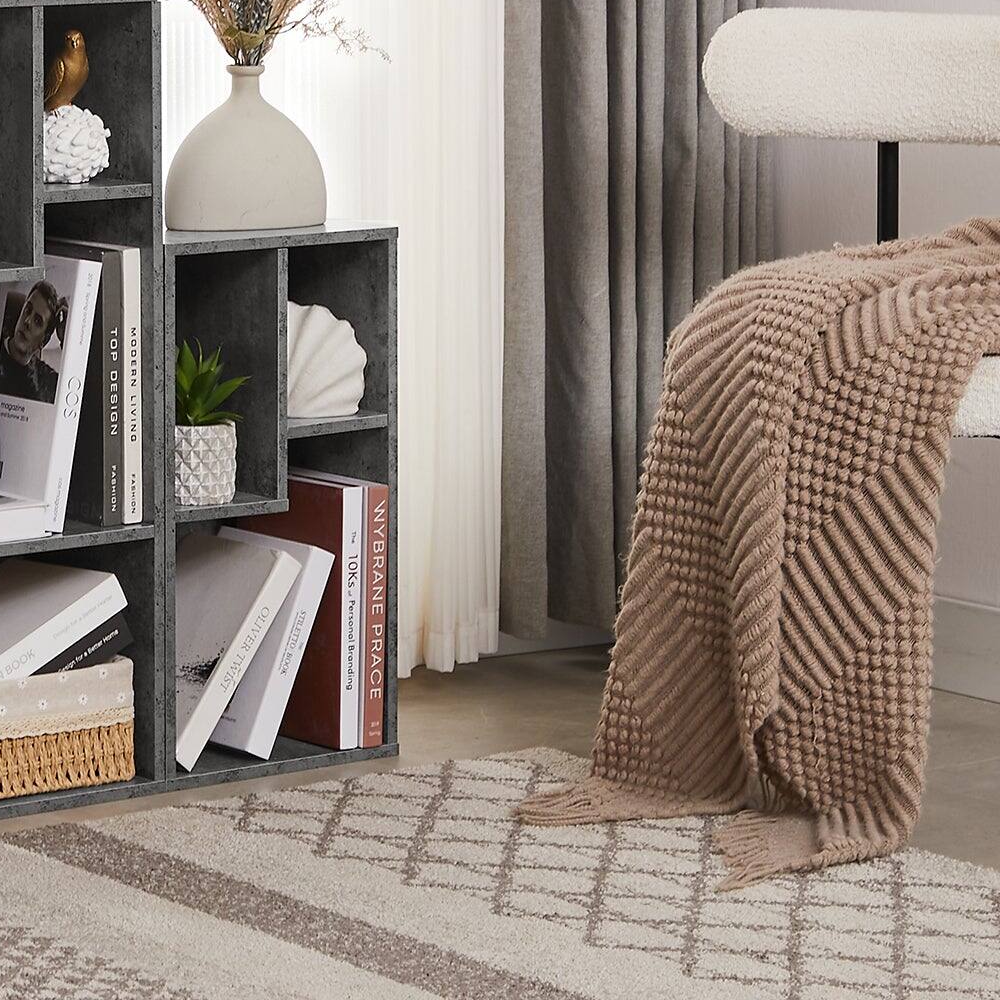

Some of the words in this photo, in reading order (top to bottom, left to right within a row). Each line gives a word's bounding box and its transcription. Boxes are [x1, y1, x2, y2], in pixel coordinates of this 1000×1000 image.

[110, 327, 118, 362] TOP
[63, 376, 81, 419] COS
[110, 370, 118, 435] DESIGN
[347, 554, 358, 591] 10Ks
[372, 500, 385, 615] WYBRANE
[87, 640, 103, 655] Better
[102, 629, 119, 644] Home
[241, 606, 270, 652] OLIVER
[348, 600, 356, 644] Personal
[5, 648, 37, 675] BOOK
[220, 654, 246, 693] TWIST
[280, 652, 293, 676] BOOK
[345, 644, 355, 691] Branding
[370, 624, 383, 699] PRACE
